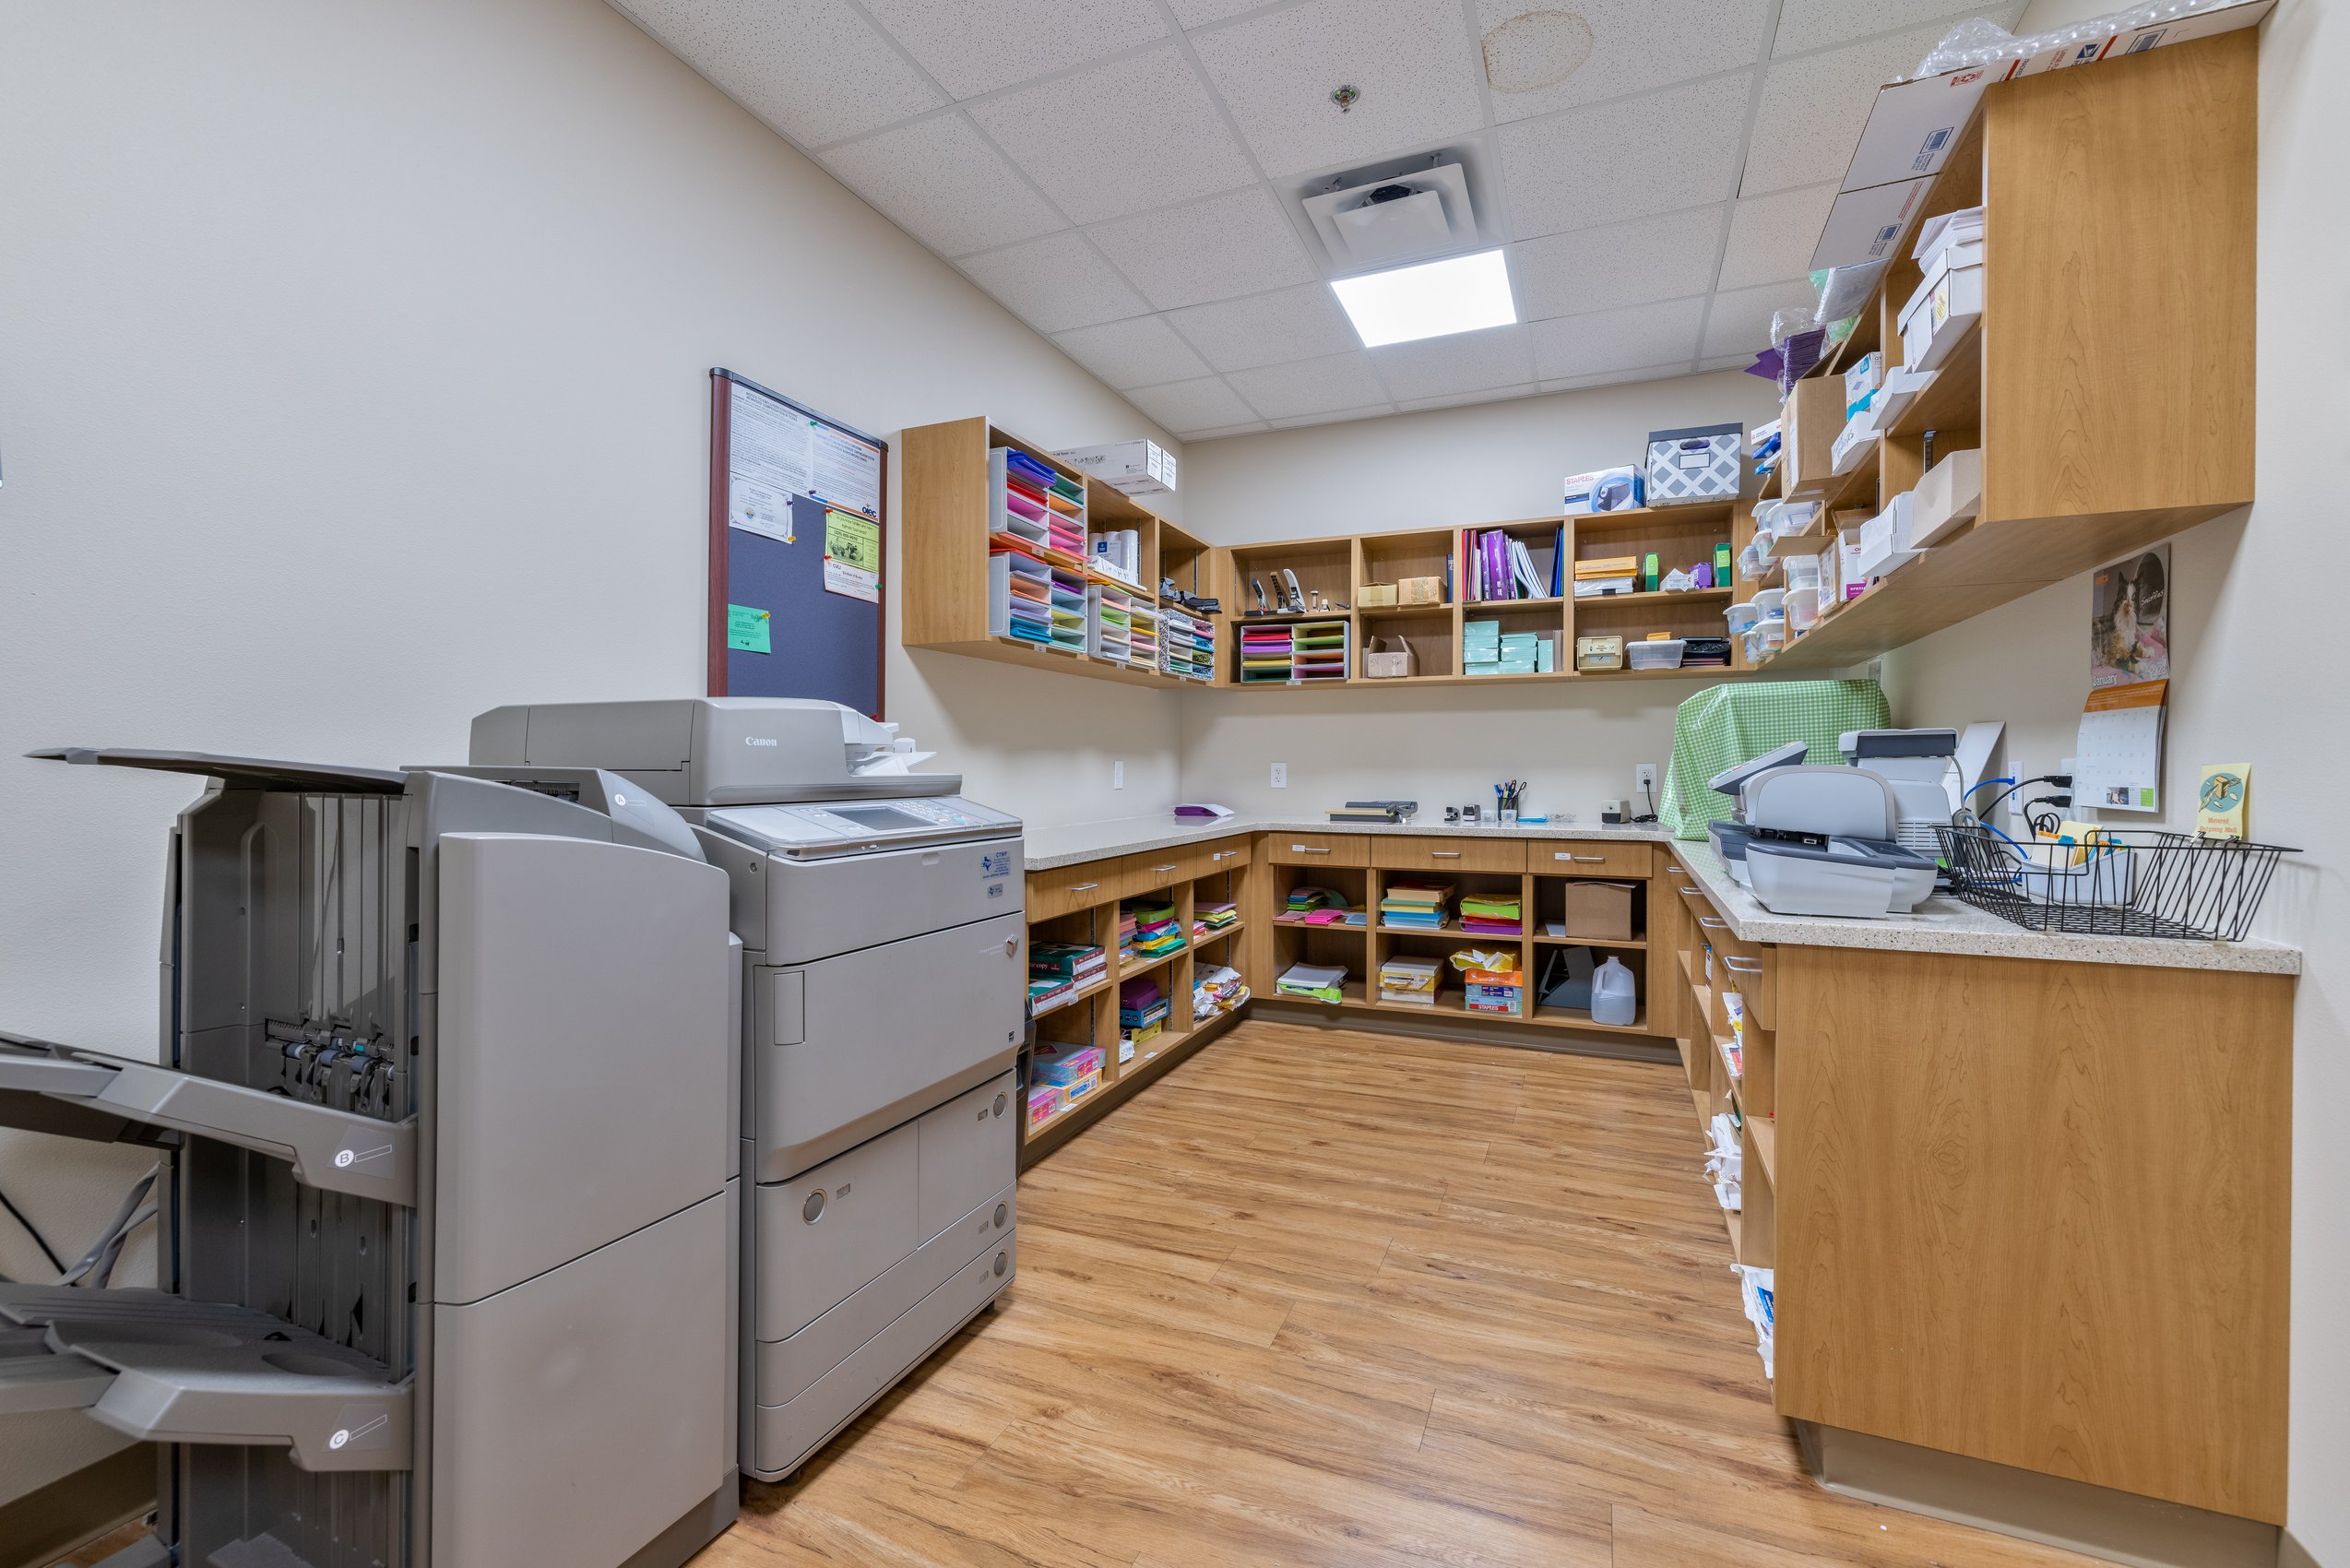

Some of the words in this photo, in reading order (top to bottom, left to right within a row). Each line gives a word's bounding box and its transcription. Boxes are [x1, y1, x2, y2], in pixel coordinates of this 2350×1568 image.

[1566, 475, 1595, 485] STAPLES
[2151, 664, 2166, 676] 2023
[2093, 674, 2118, 687] January
[745, 736, 777, 747] Canon
